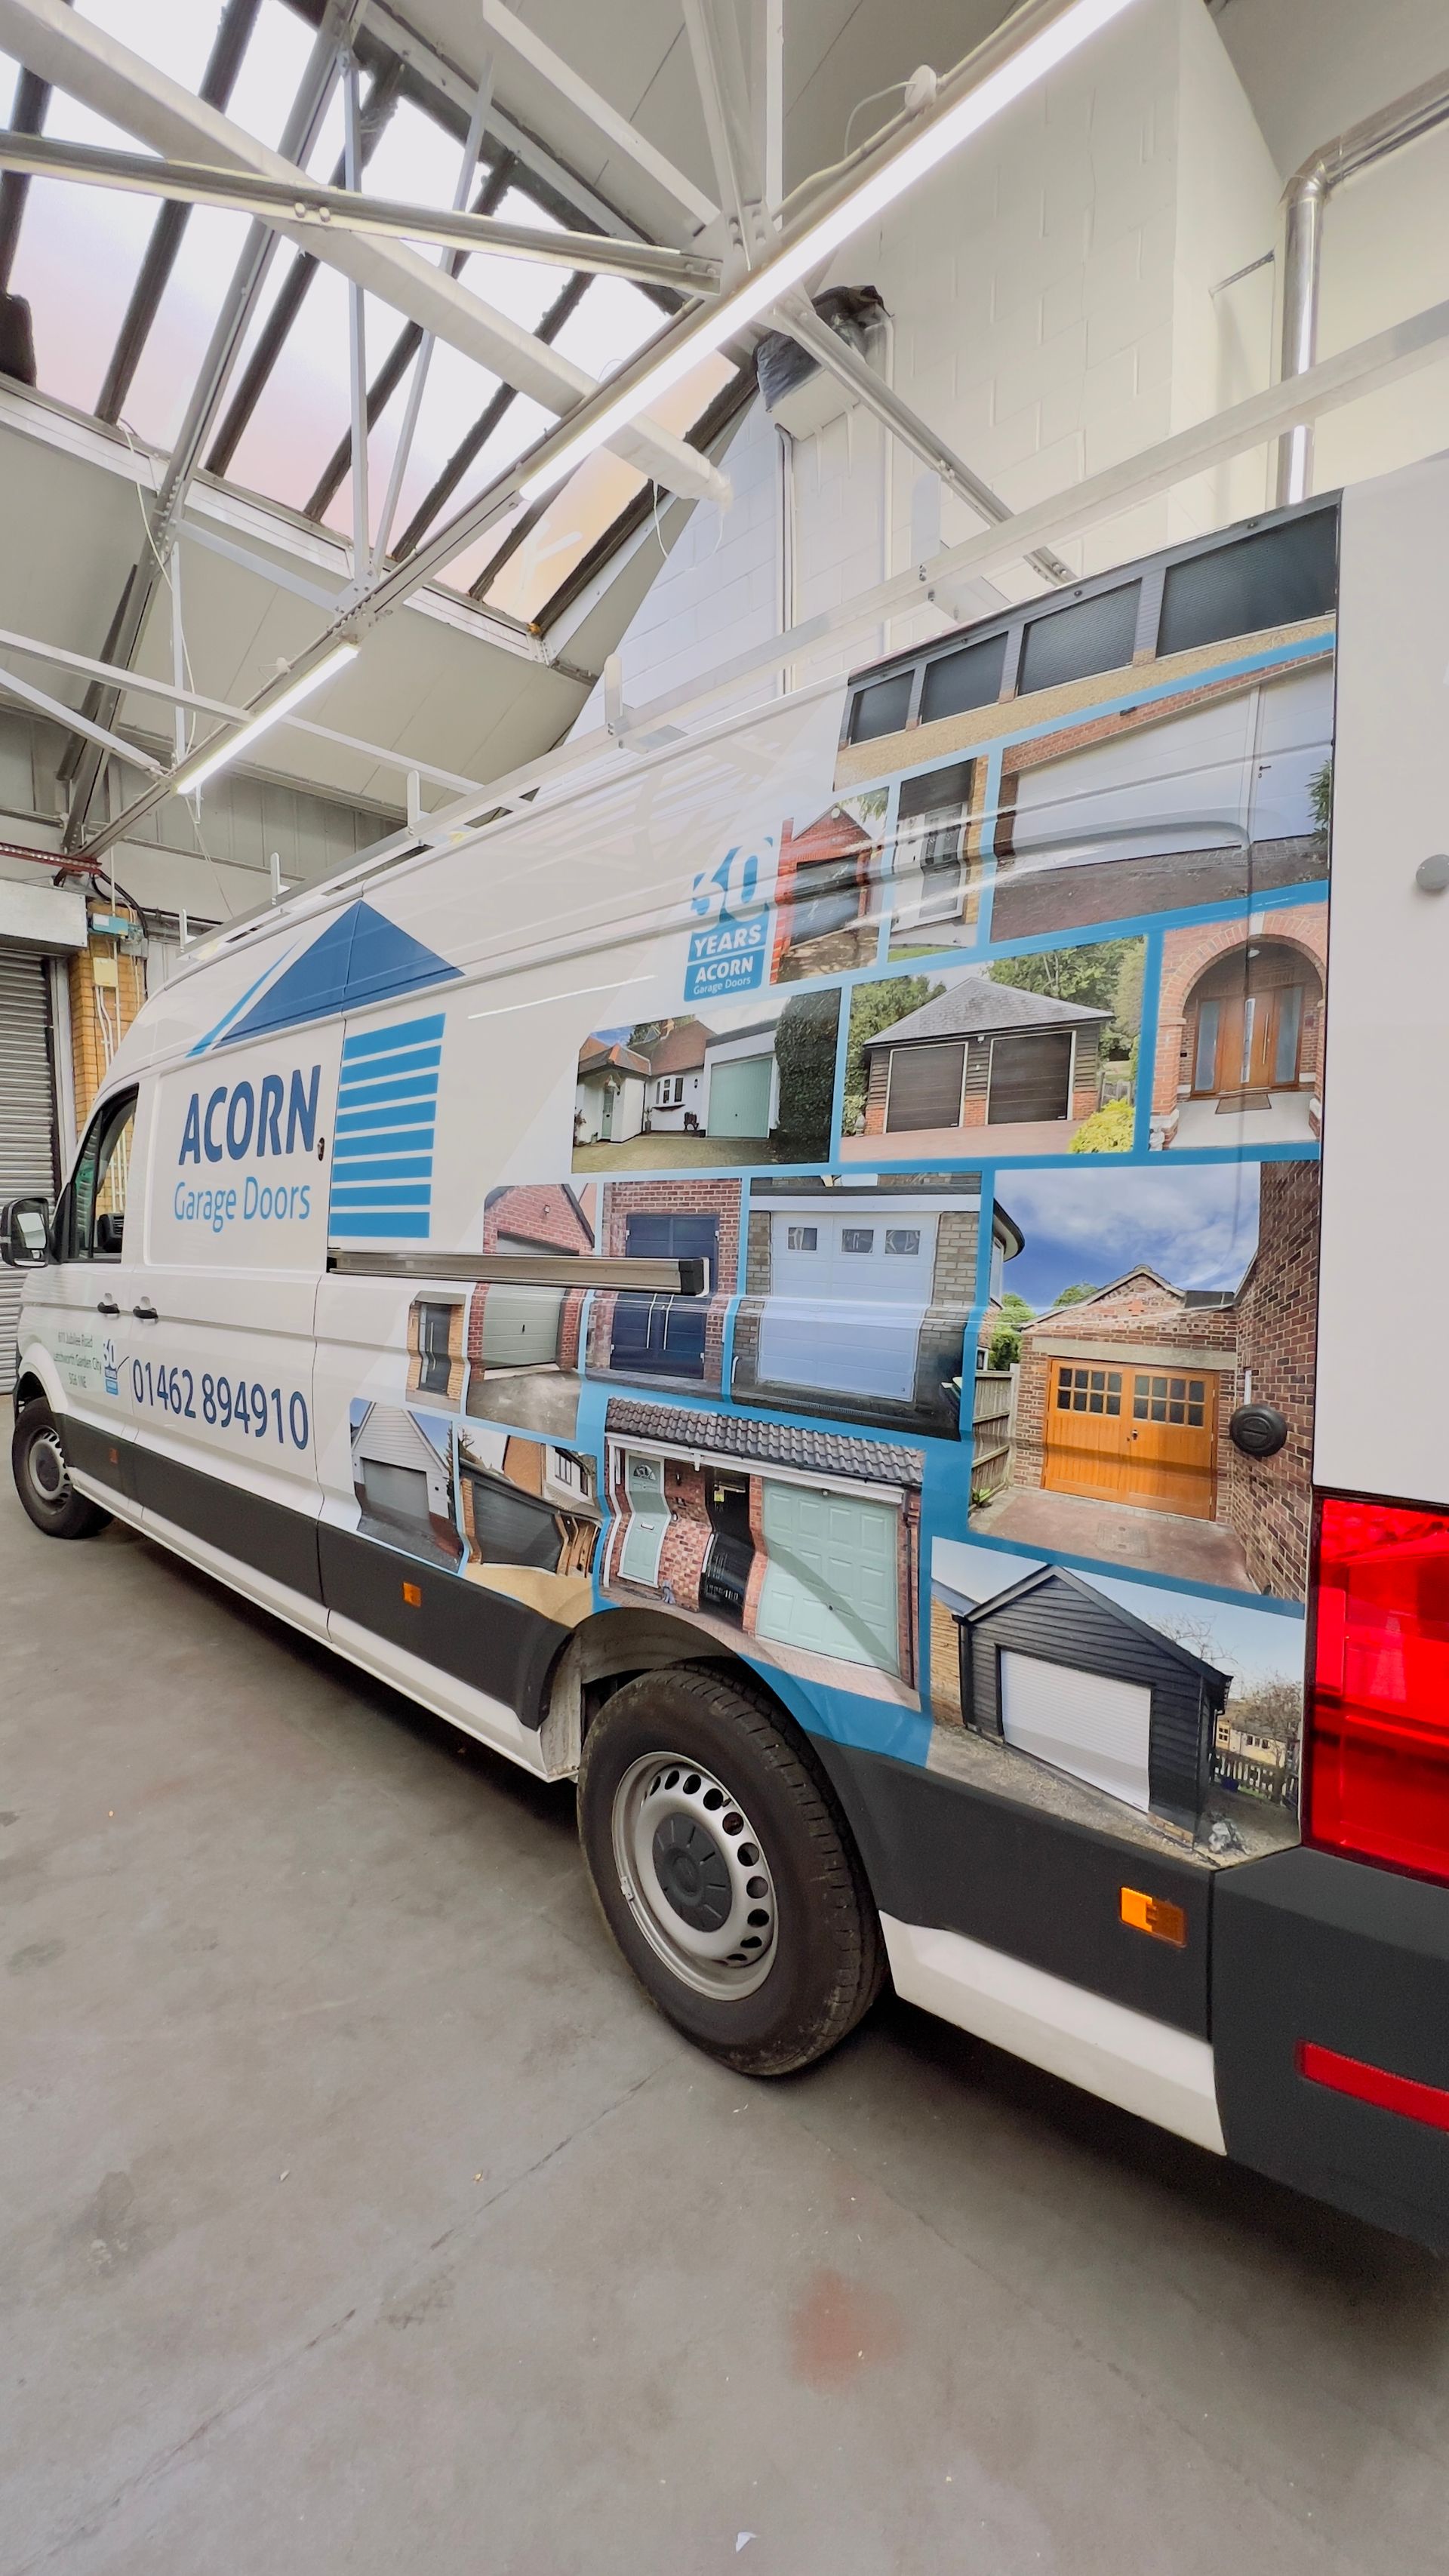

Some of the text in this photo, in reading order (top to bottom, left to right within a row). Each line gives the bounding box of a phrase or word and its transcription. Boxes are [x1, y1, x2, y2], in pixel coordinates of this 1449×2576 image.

[690, 836, 775, 934] 30
[694, 924, 761, 958] YEARS
[694, 977, 752, 995] Garage Doors
[695, 956, 754, 983] ACORN
[178, 1064, 321, 1165] ACORN
[174, 1176, 311, 1233] Garage Doors
[81, 1334, 93, 1348] Road
[75, 1353, 91, 1368] Garden
[93, 1357, 102, 1374] City
[133, 1359, 309, 1450] 01462 894910
